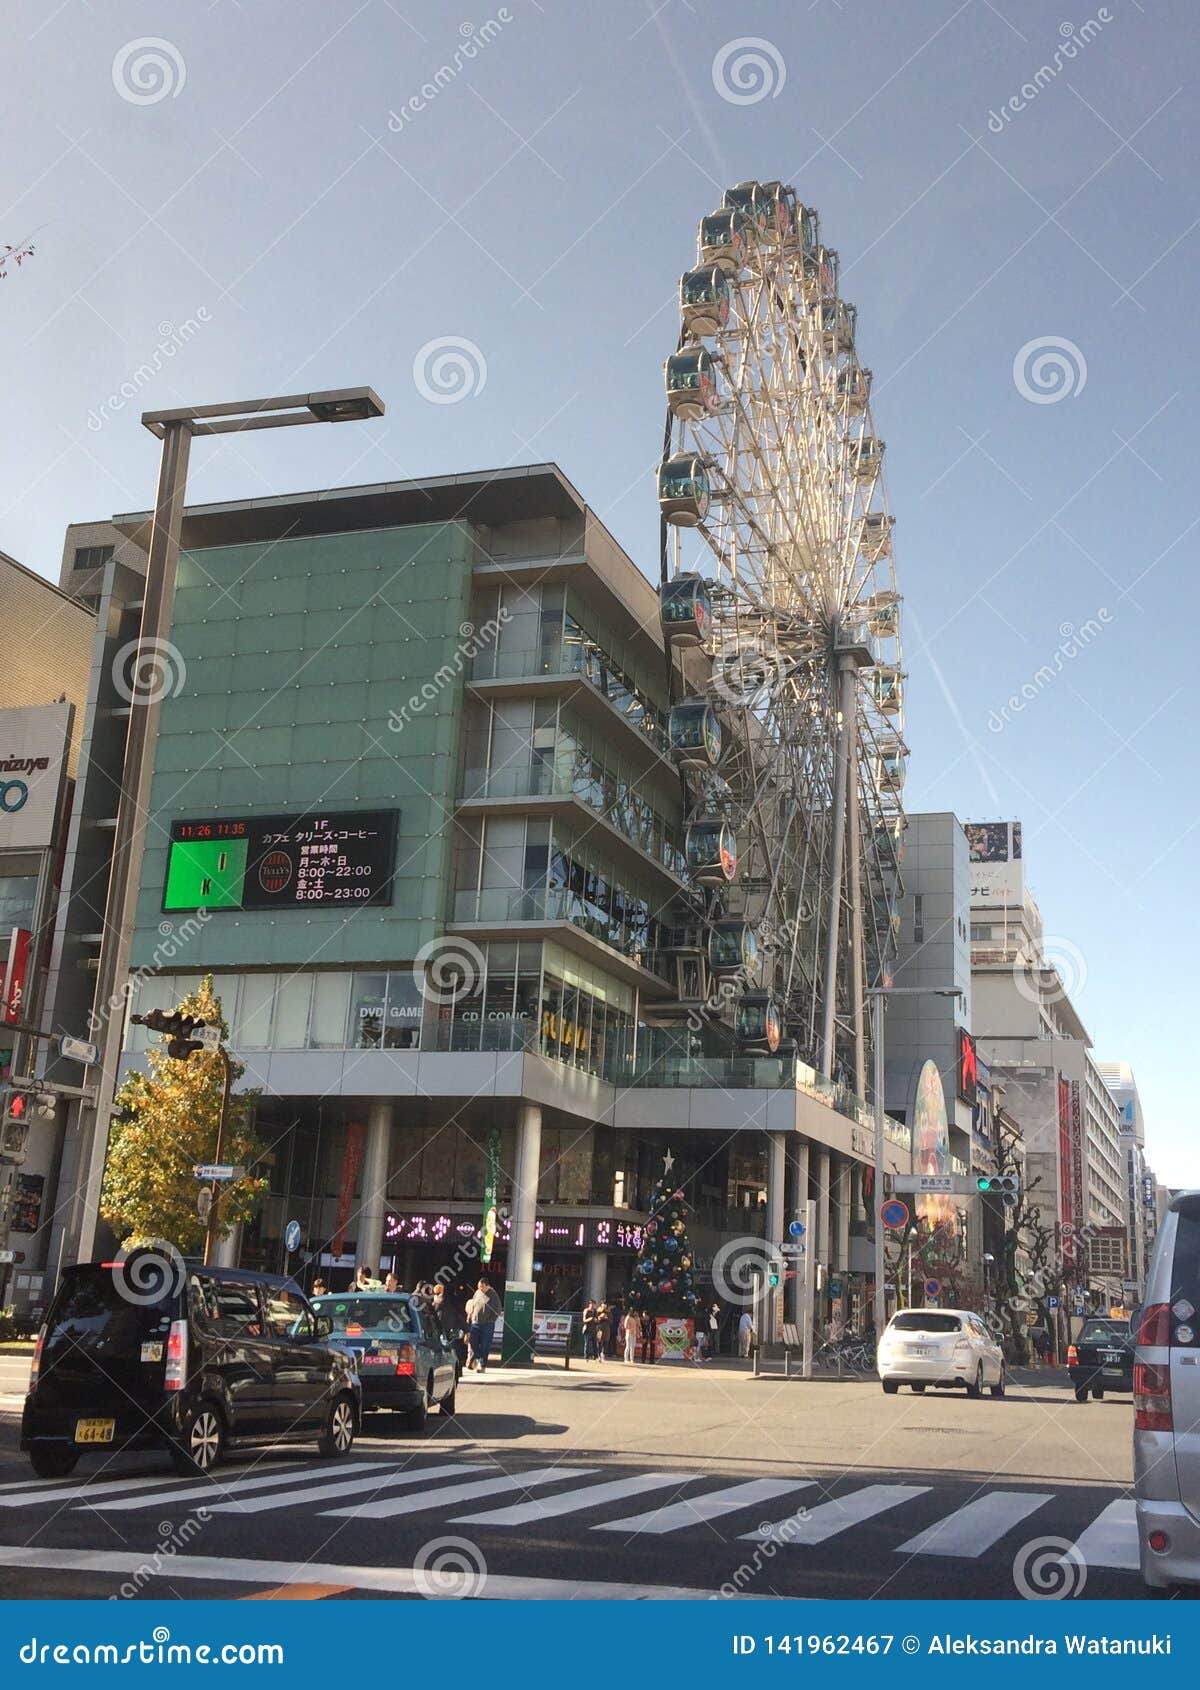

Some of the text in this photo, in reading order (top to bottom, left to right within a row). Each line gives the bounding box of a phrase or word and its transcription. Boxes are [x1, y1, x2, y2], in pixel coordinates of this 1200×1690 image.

[314, 821, 328, 830] 1F
[263, 830, 377, 843] カフェ タリーズ・コーヒー
[360, 1007, 424, 1018] DVD GAME
[462, 1012, 479, 1022] CD
